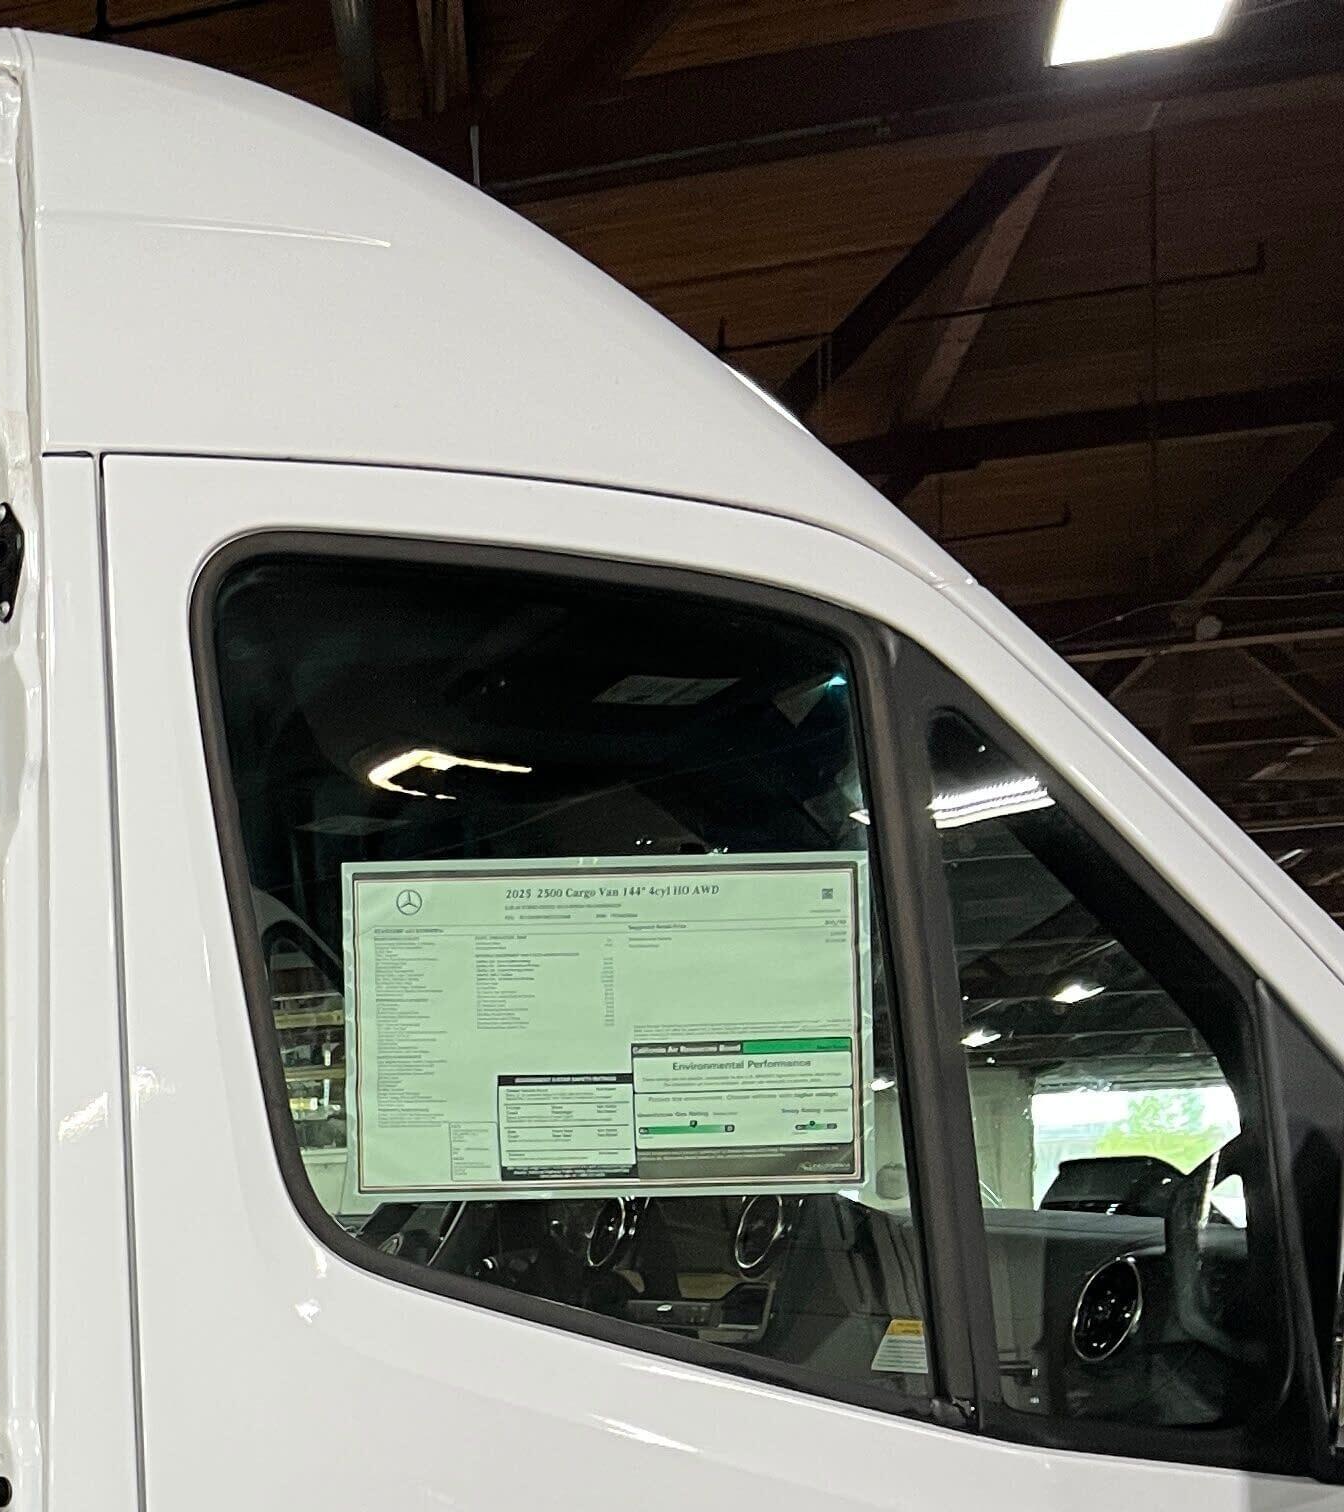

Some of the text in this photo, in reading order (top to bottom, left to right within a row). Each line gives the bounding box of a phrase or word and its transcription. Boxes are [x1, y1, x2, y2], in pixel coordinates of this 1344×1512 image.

[506, 888, 531, 899] 2025
[537, 888, 563, 898] 2500
[565, 887, 596, 899] Cargo
[599, 887, 619, 897] Van
[692, 884, 720, 895] AWD
[747, 1059, 812, 1069] Performance
